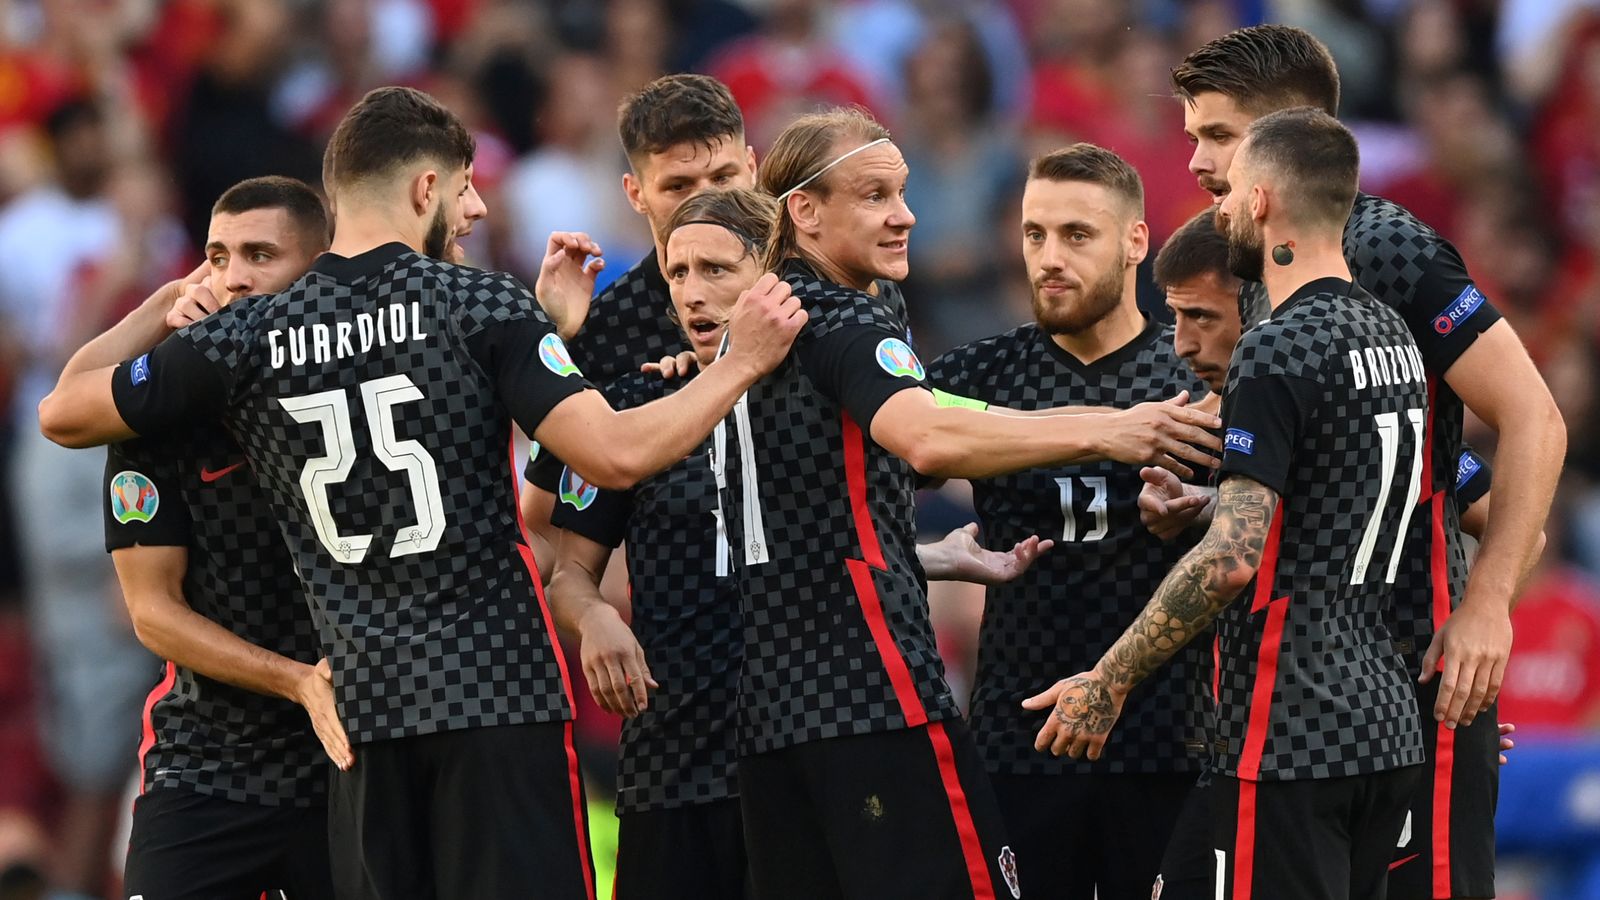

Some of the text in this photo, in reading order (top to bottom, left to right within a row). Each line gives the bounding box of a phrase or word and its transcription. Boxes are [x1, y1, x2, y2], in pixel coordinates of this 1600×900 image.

[1449, 288, 1480, 321] RESPECT
[277, 373, 447, 564] 25
[1054, 476, 1109, 542] 13
[1350, 408, 1424, 586] 11
